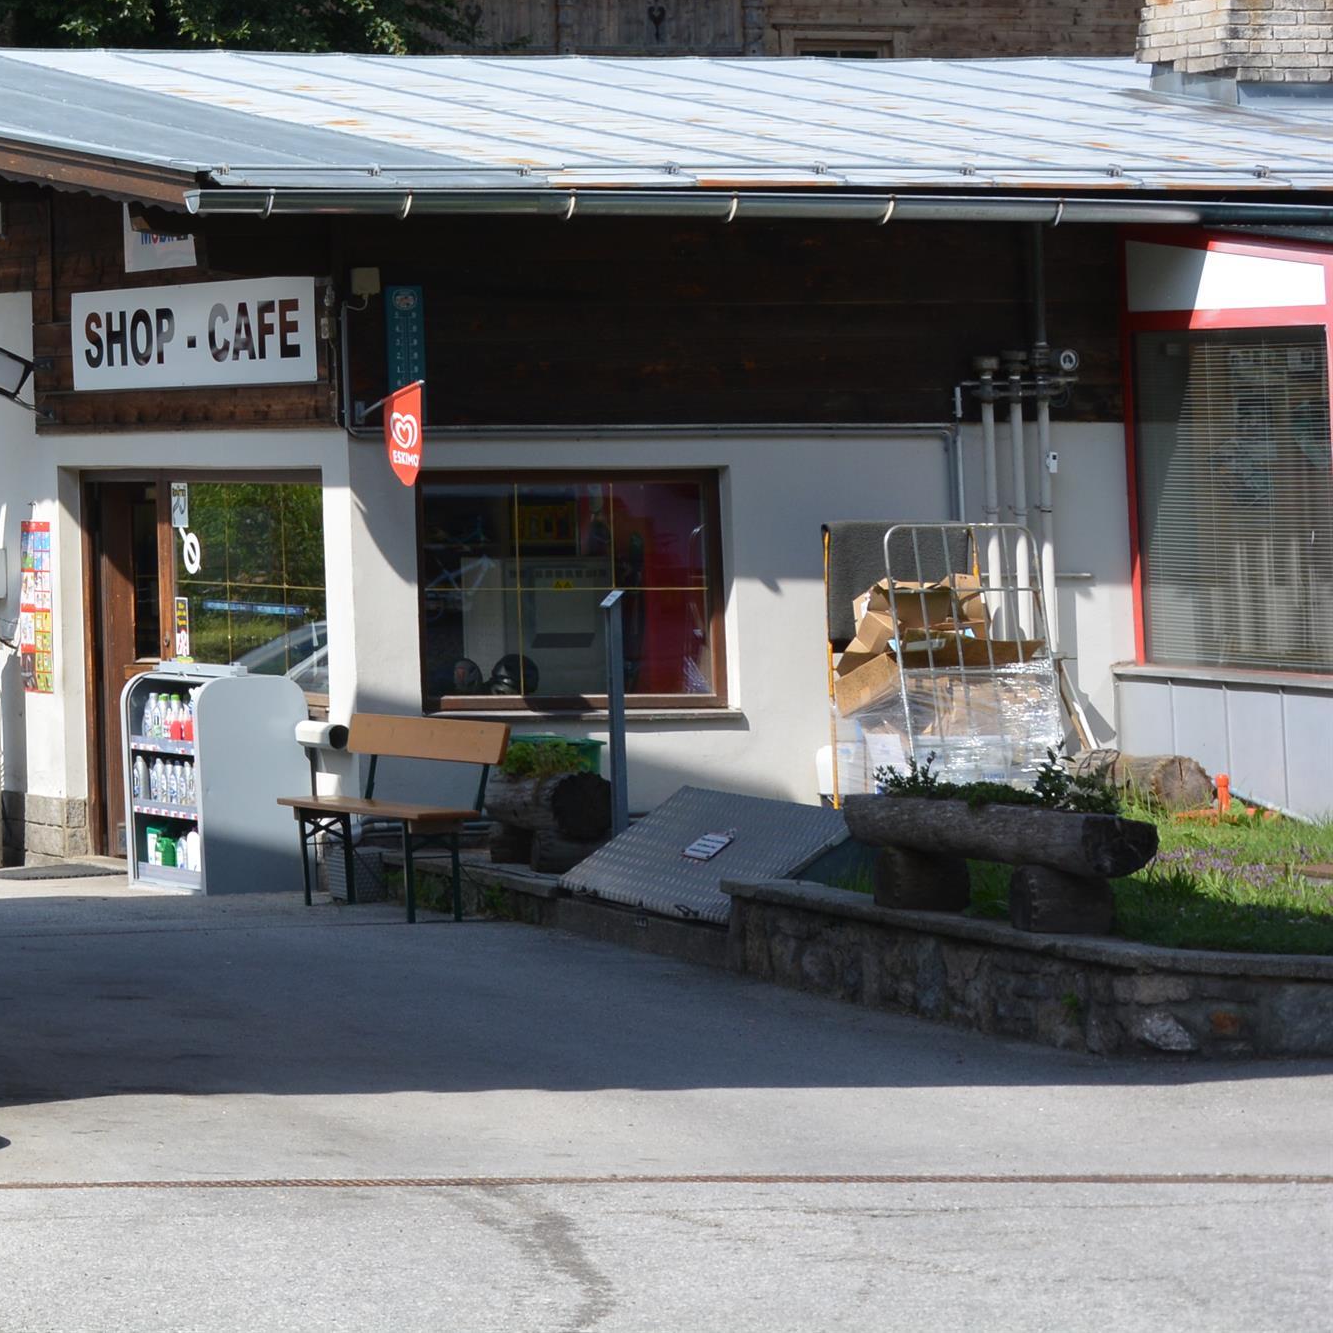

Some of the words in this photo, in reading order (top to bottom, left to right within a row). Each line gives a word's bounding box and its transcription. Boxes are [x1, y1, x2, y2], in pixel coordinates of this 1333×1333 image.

[84, 307, 176, 369] SHOP
[208, 298, 301, 363] CAFE
[392, 449, 420, 468] ESKIMO
